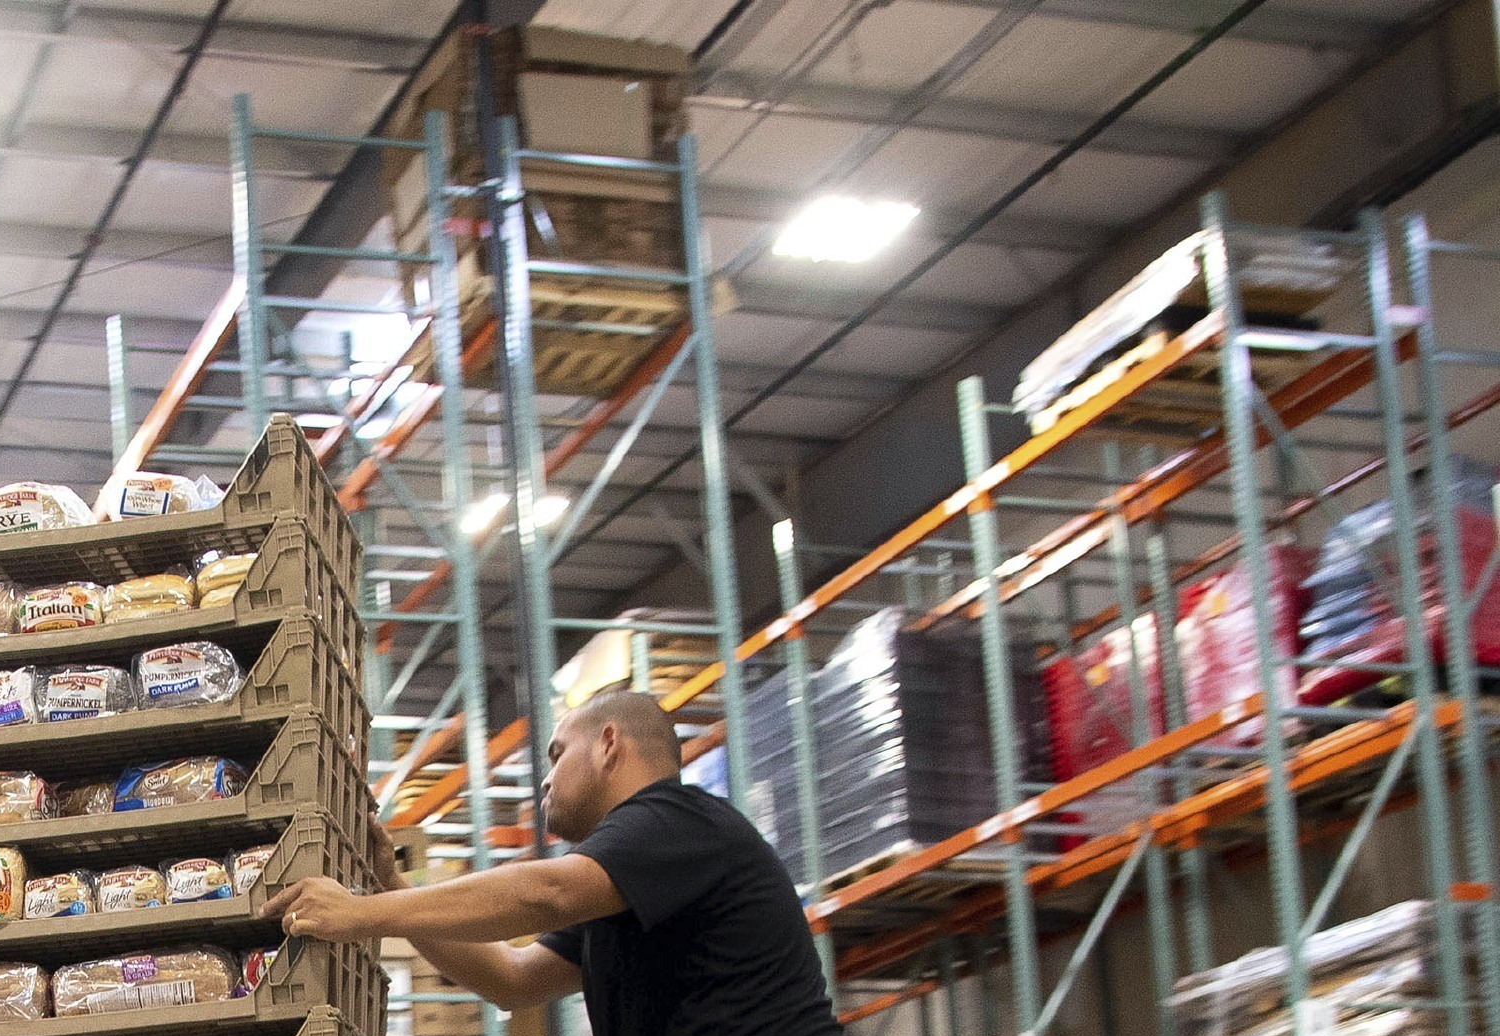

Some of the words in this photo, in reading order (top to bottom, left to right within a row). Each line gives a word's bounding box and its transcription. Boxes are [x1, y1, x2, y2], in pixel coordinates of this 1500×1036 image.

[28, 602, 82, 620] Italian
[151, 686, 173, 695] DARK
[147, 775, 167, 788] Swirl
[174, 875, 204, 895] Light
[27, 893, 55, 915] Light
[104, 889, 132, 909] Light
